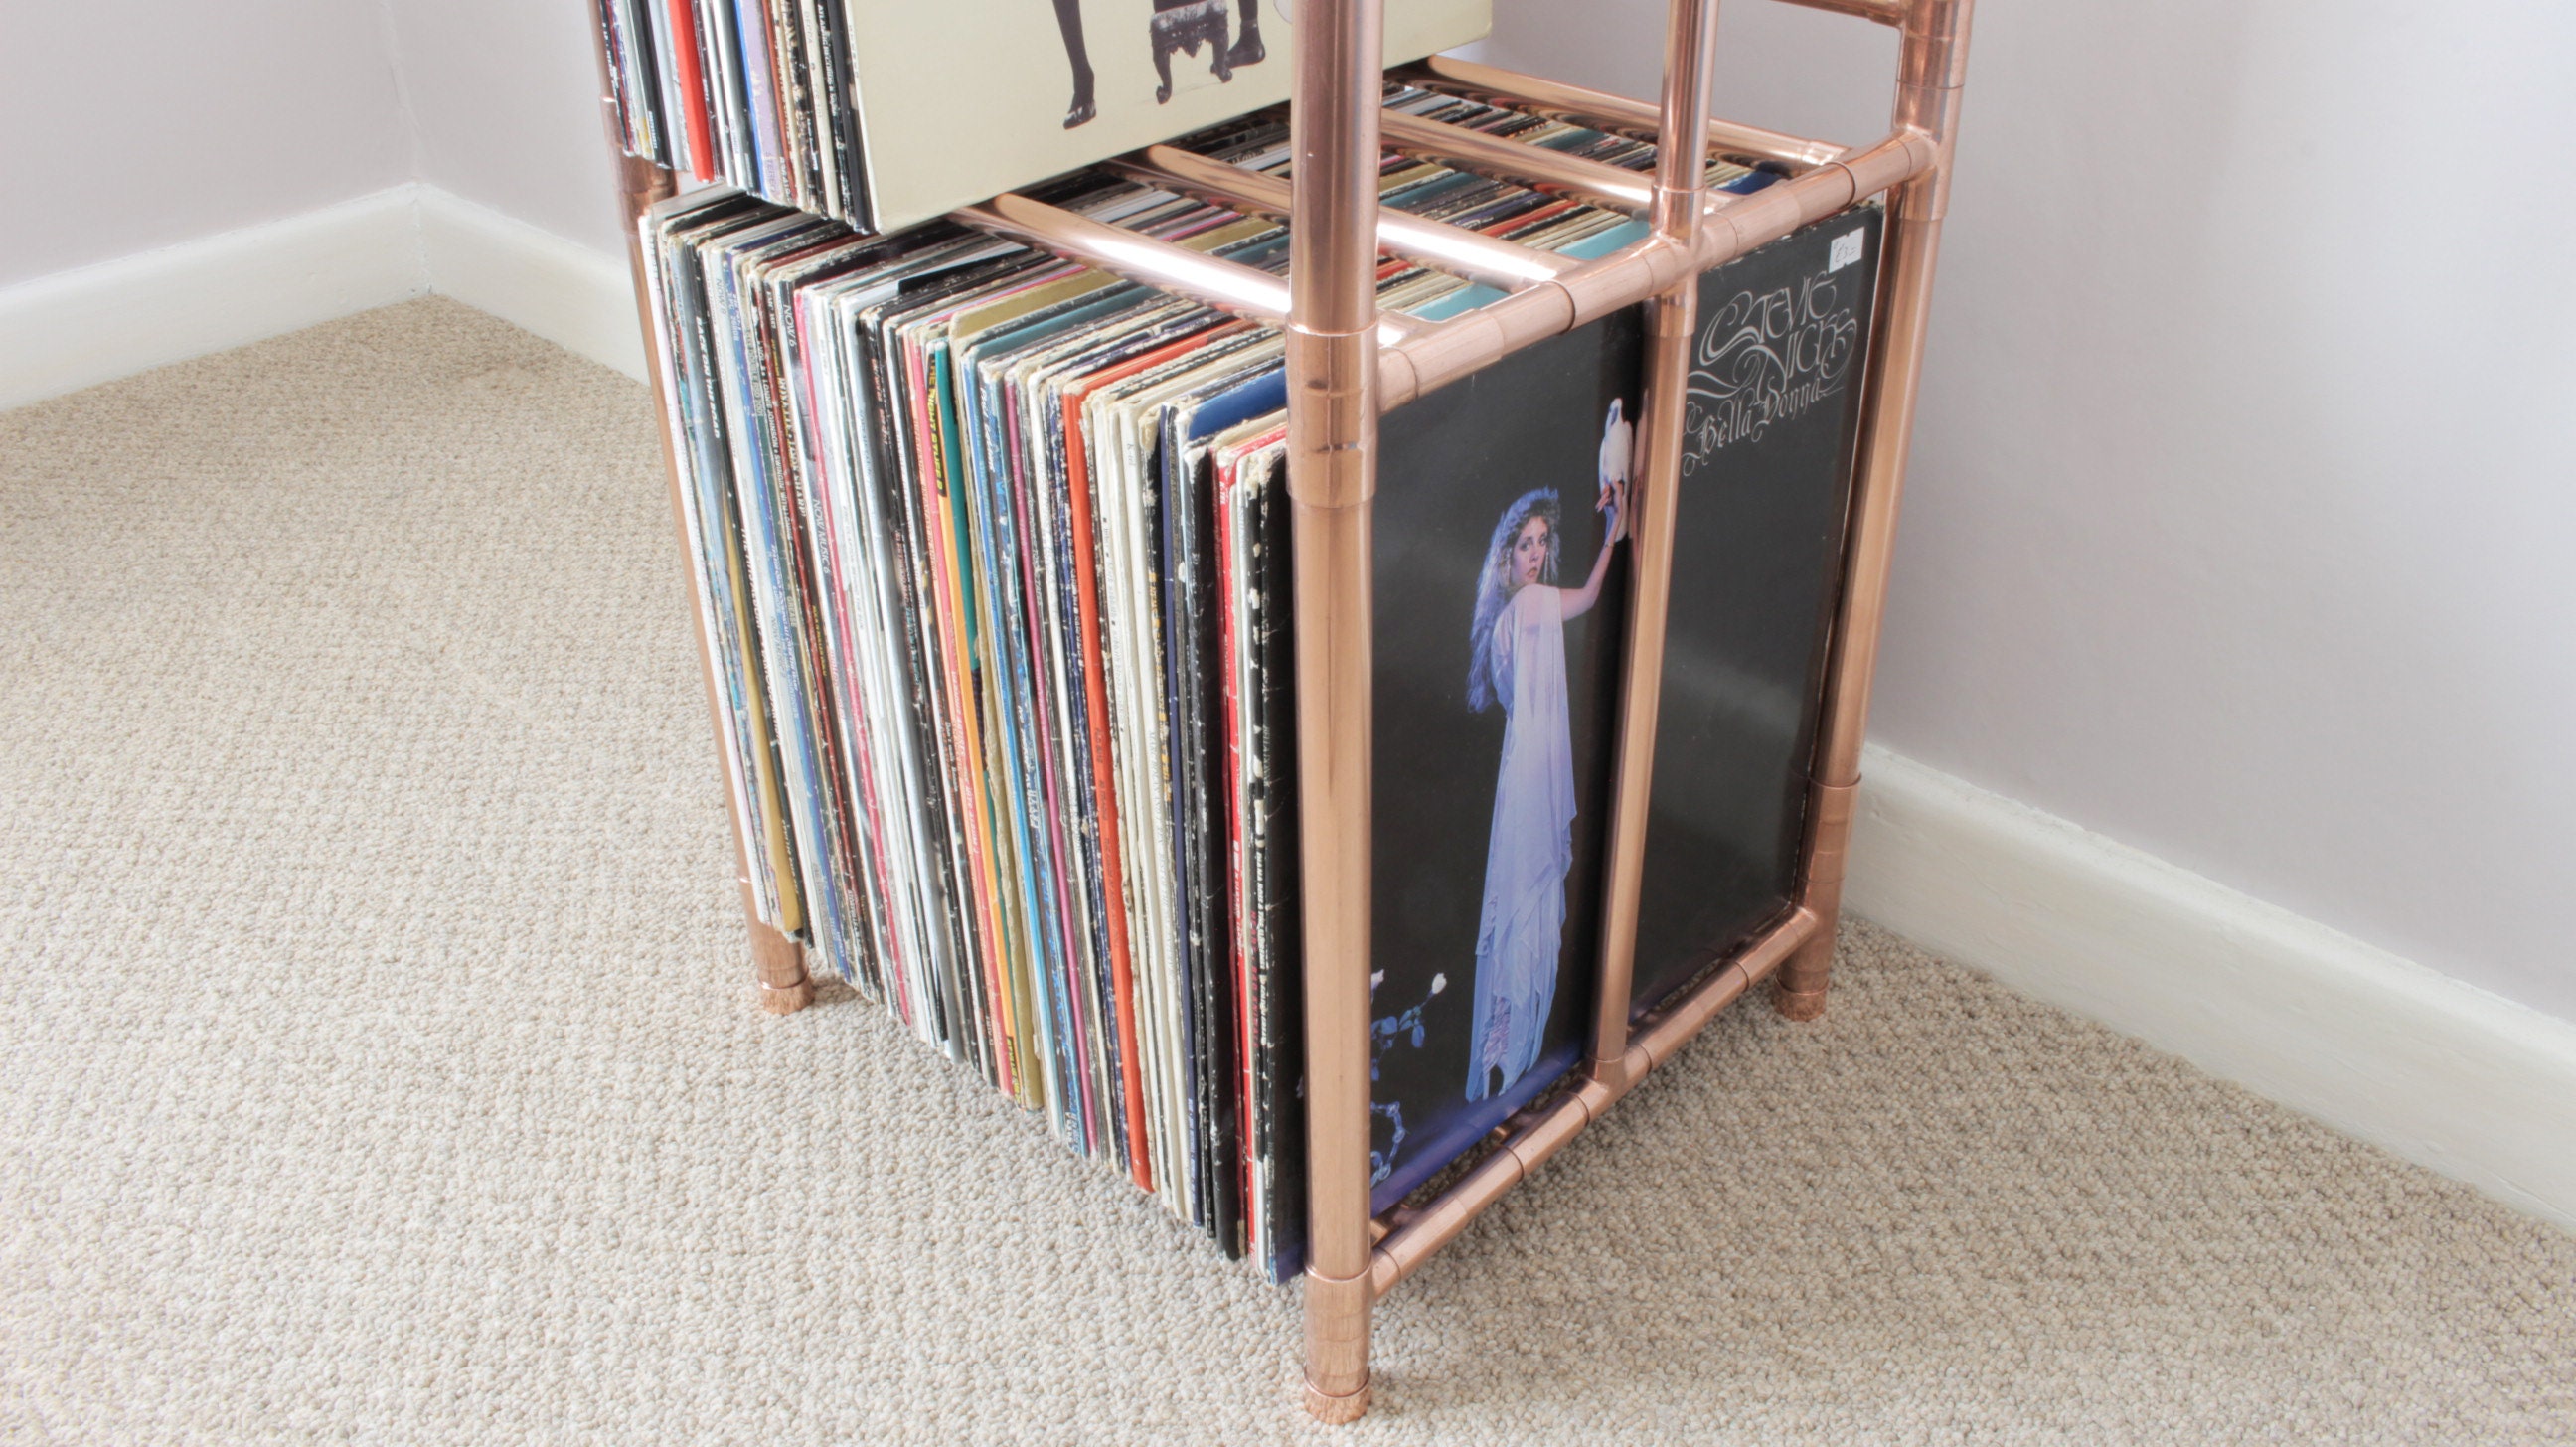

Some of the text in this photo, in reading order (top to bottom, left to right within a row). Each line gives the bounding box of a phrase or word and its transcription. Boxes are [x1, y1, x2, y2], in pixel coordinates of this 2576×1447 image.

[713, 277, 727, 306] NOW
[781, 304, 798, 348] NOW 6
[1700, 270, 1837, 367] STEVIE
[692, 315, 723, 439] BACK ON THE ROAD
[1731, 308, 1857, 395] NICKS
[765, 408, 780, 448] JOHNSON
[924, 387, 938, 431] RIGHT
[1683, 376, 1834, 476] Bella Donna
[811, 498, 832, 575] NOW MUSIC 6
